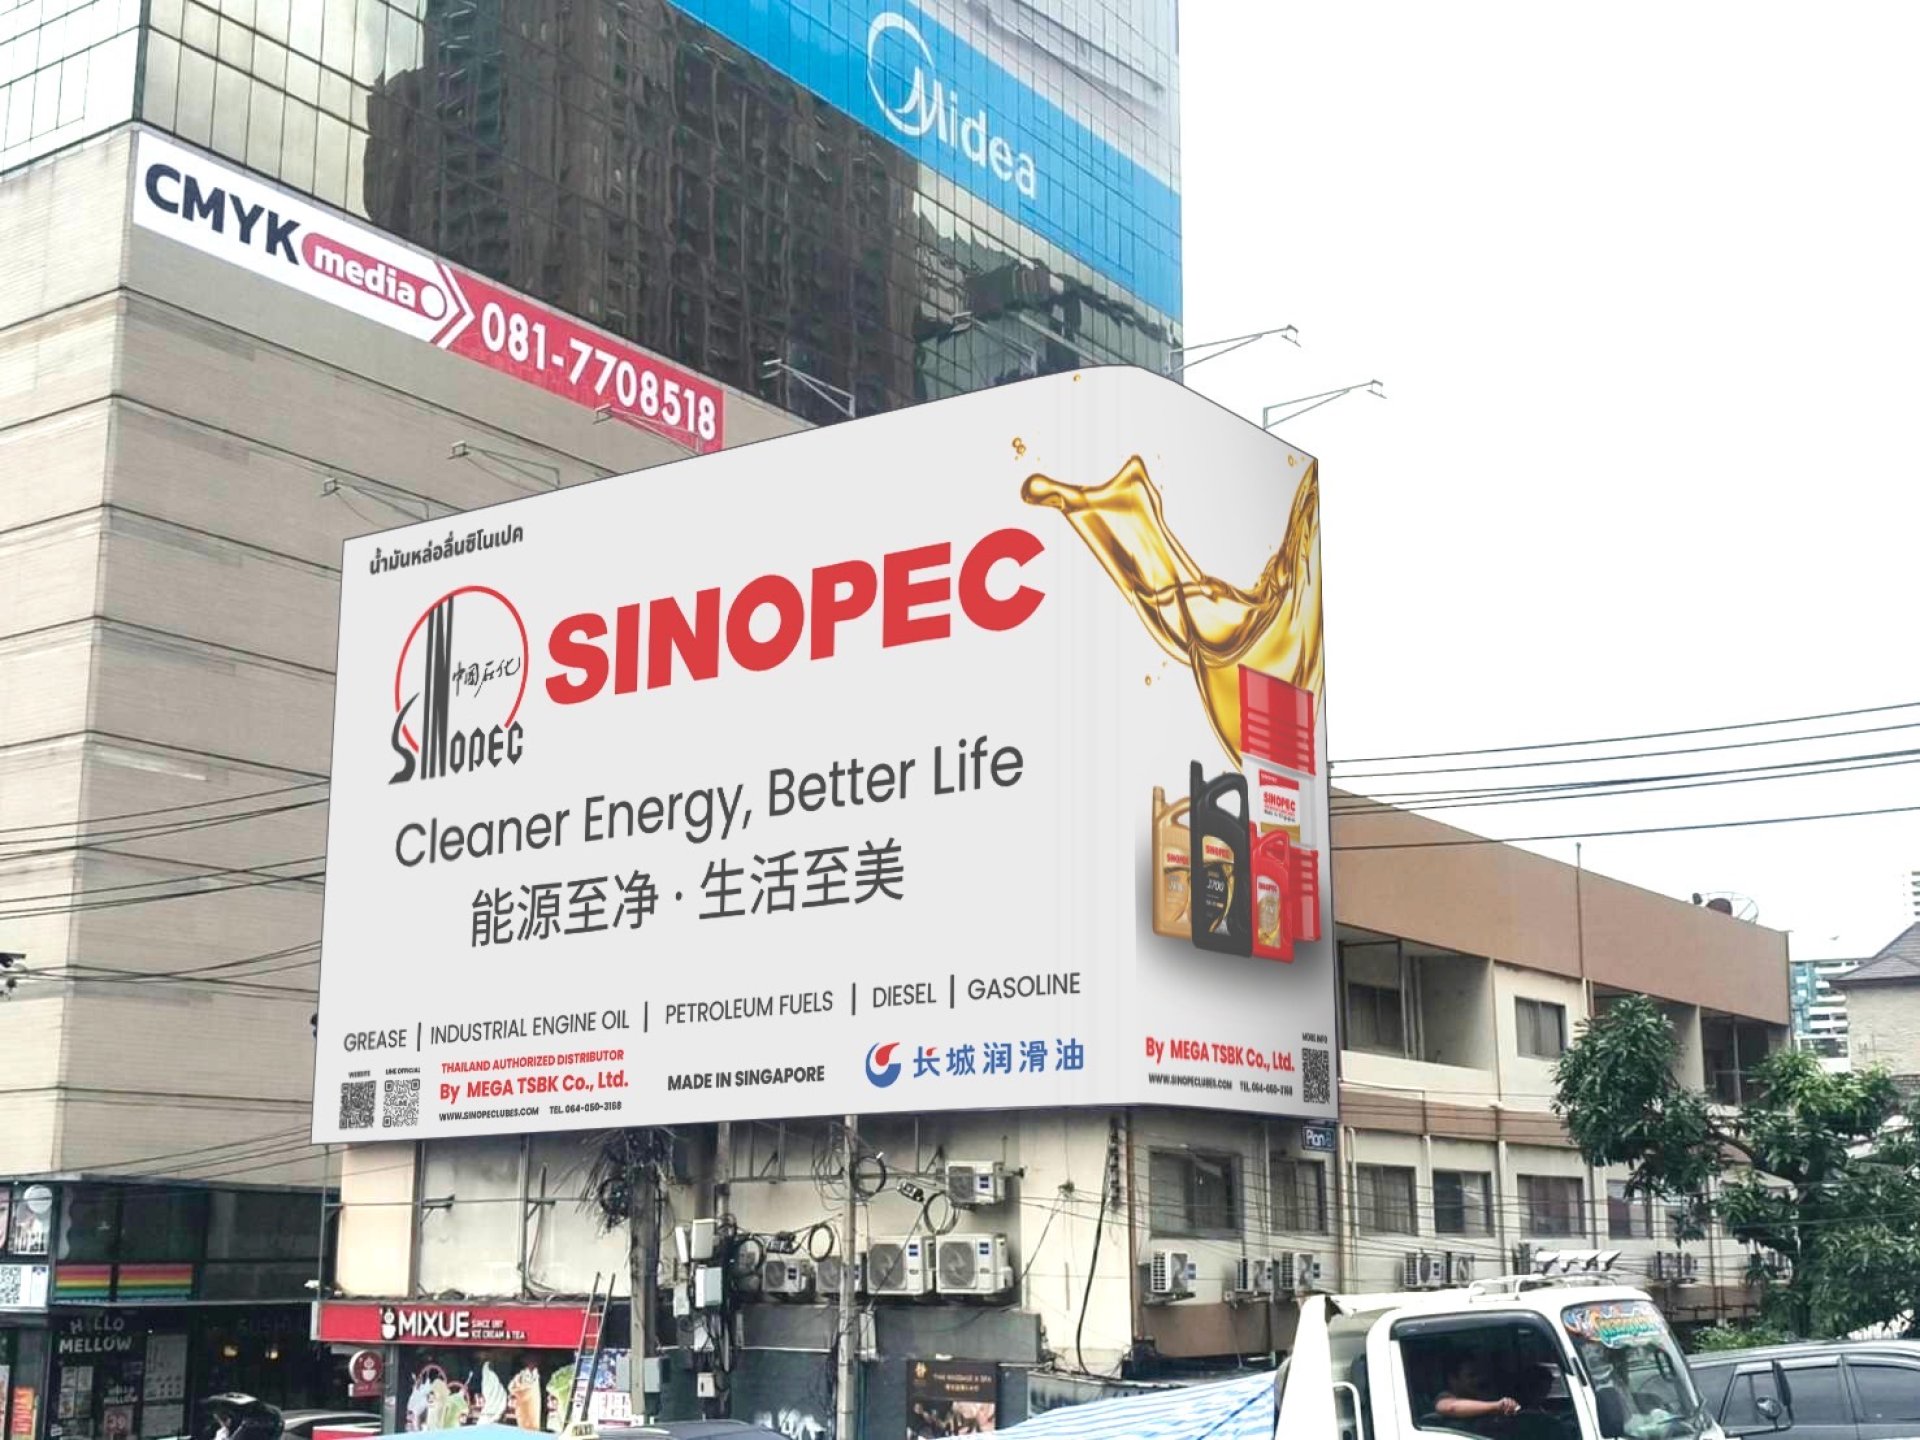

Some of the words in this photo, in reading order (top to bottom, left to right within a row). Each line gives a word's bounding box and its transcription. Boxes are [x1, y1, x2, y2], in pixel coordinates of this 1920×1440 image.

[880, 38, 1037, 200] Midea
[145, 164, 303, 266] CMYK
[312, 244, 417, 308] media
[480, 301, 716, 441] 081-7708518
[545, 527, 1046, 706] SINOPEC
[395, 808, 570, 868] Cleaner
[584, 783, 753, 845] Energy,
[768, 758, 916, 817] Better
[933, 734, 1024, 796] Life
[343, 1028, 408, 1053] GREASE
[430, 1018, 528, 1045] INDUSTRIAL
[532, 1011, 597, 1037] ENGINE
[601, 1009, 630, 1030] OIL
[665, 996, 774, 1025] PETROLEUM
[779, 991, 834, 1016] FUELS
[872, 983, 937, 1009] DIESEL
[967, 972, 1081, 1001] GASOLINE
[441, 1059, 491, 1074] THAILAND
[493, 1054, 555, 1070] AUTHORIZED
[557, 1049, 625, 1066] DISTRIBUTOR
[912, 1037, 1084, 1079] 长城润滑油
[1145, 1036, 1164, 1064] By
[1170, 1039, 1210, 1062] MEGA
[1211, 1043, 1245, 1066] TSBK
[1246, 1048, 1271, 1072] Co.,
[1272, 1051, 1296, 1072] Ltd.
[439, 1083, 461, 1105] By
[466, 1078, 514, 1099] MEGA
[516, 1075, 560, 1095] TSBK
[562, 1074, 595, 1093] Co.,
[598, 1069, 630, 1089] Ltd.
[667, 1073, 712, 1092] MADE
[715, 1071, 731, 1088] IN
[734, 1065, 825, 1088] SINGAPORE
[438, 1106, 540, 1122] WWW.SINOPECLUBES.COM
[398, 1310, 470, 1338] MIXUE
[58, 1335, 133, 1354] MELLOW
